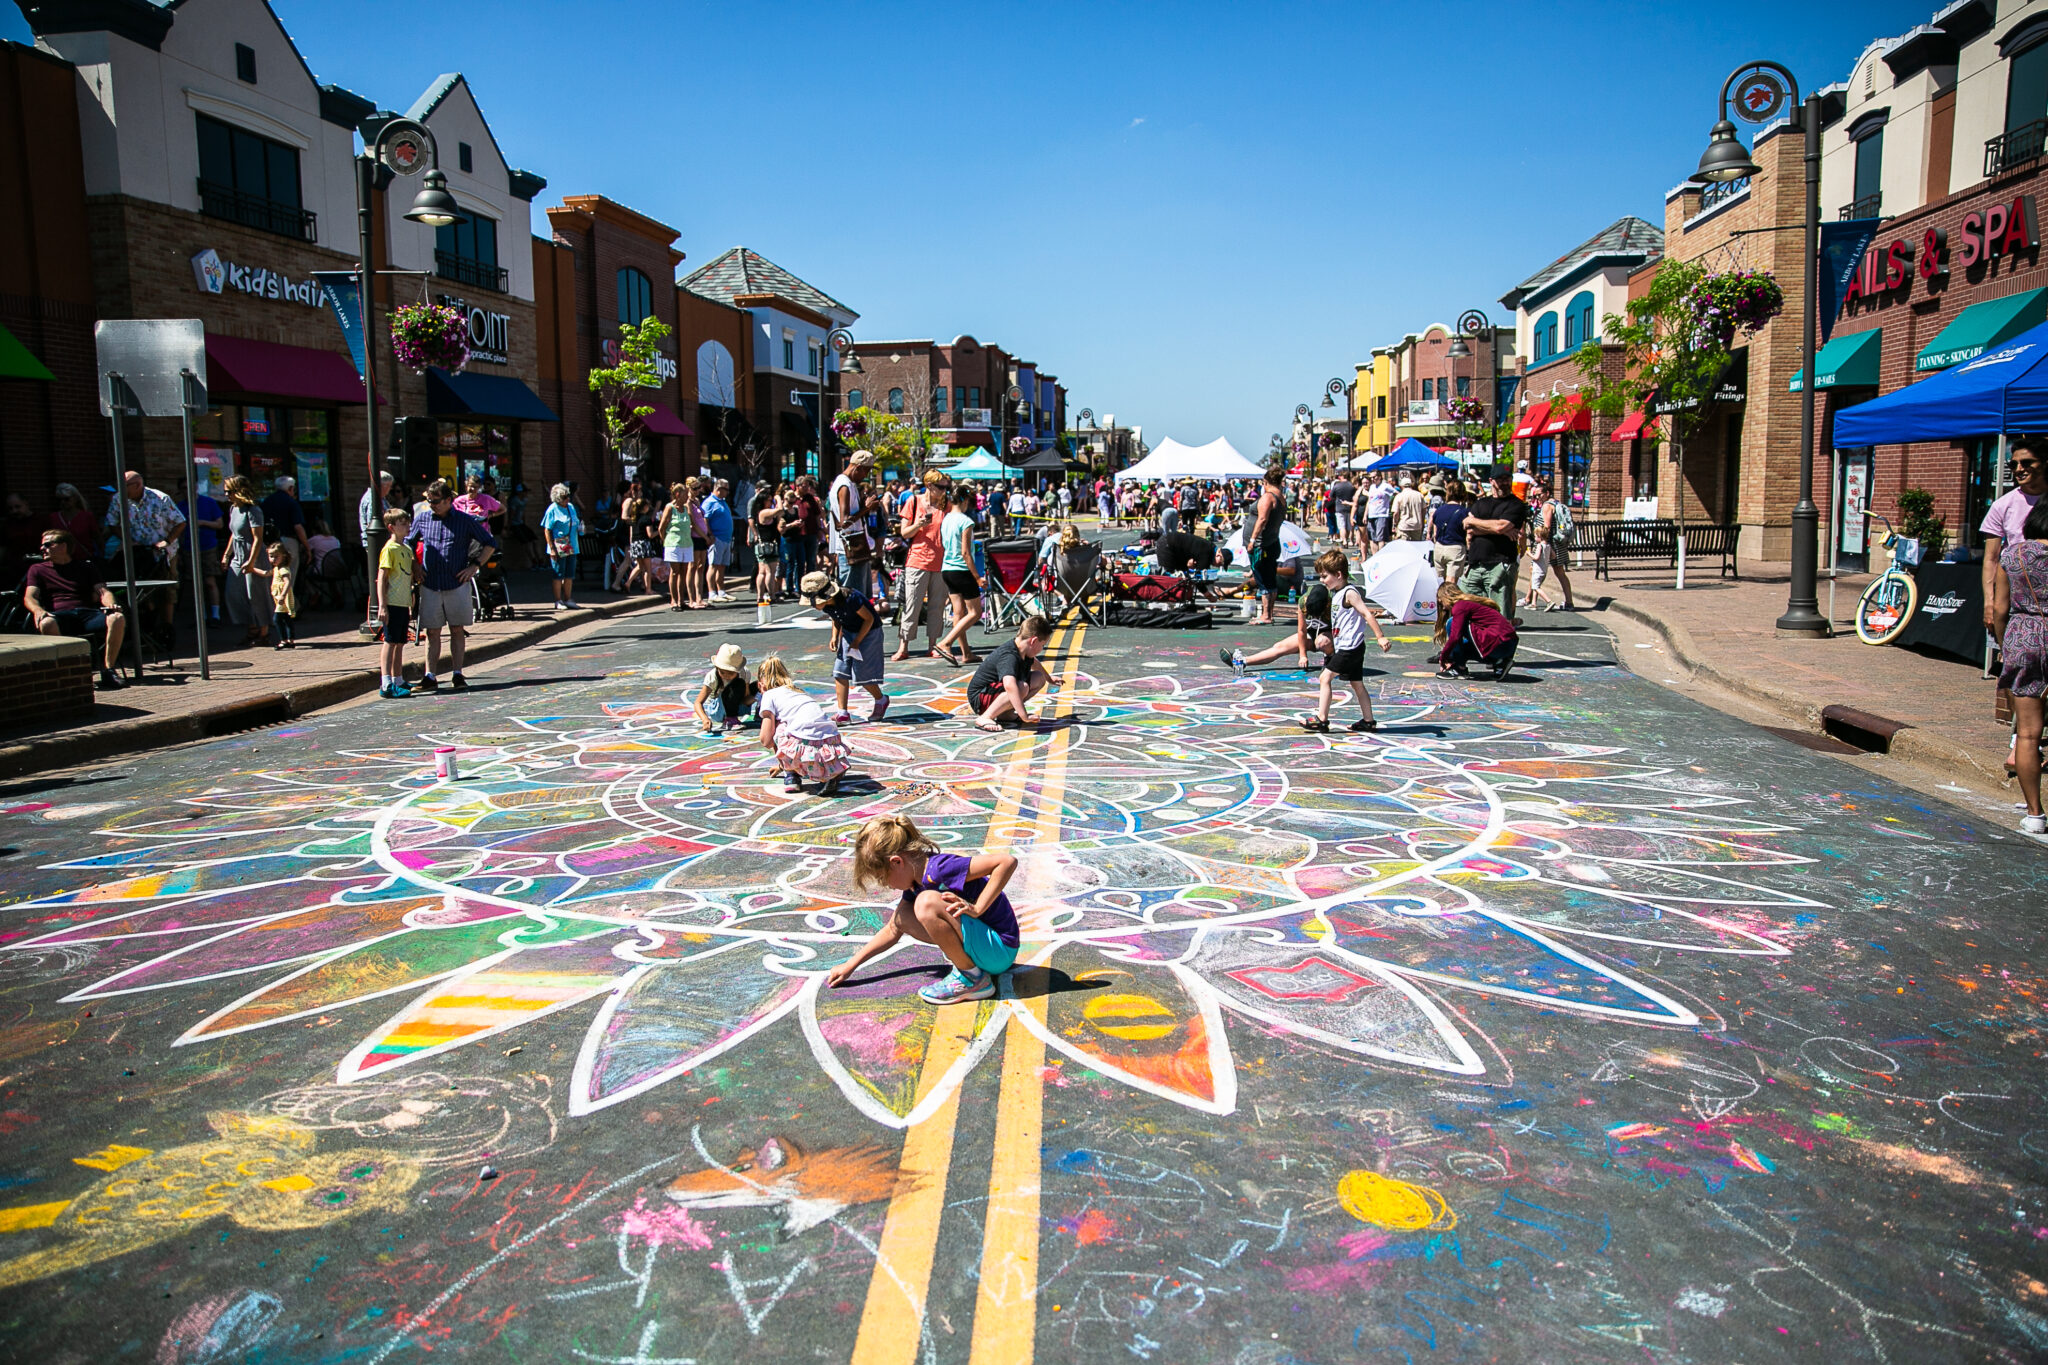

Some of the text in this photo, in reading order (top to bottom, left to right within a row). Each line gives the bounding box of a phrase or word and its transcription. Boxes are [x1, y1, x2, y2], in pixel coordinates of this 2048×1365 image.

[1840, 233, 1869, 285] ARBOR LAKES
[1843, 239, 1907, 302] AILS
[1958, 195, 2031, 267] SPA
[283, 276, 329, 309] hair
[325, 284, 350, 329] ARBOR LAKES
[444, 295, 464, 311] THE
[466, 305, 511, 351] JOINT
[1919, 353, 1945, 368] TANNING
[1950, 346, 1983, 363] SKINCARE
[1714, 392, 1745, 402] Fittings
[242, 421, 268, 432] OPEN
